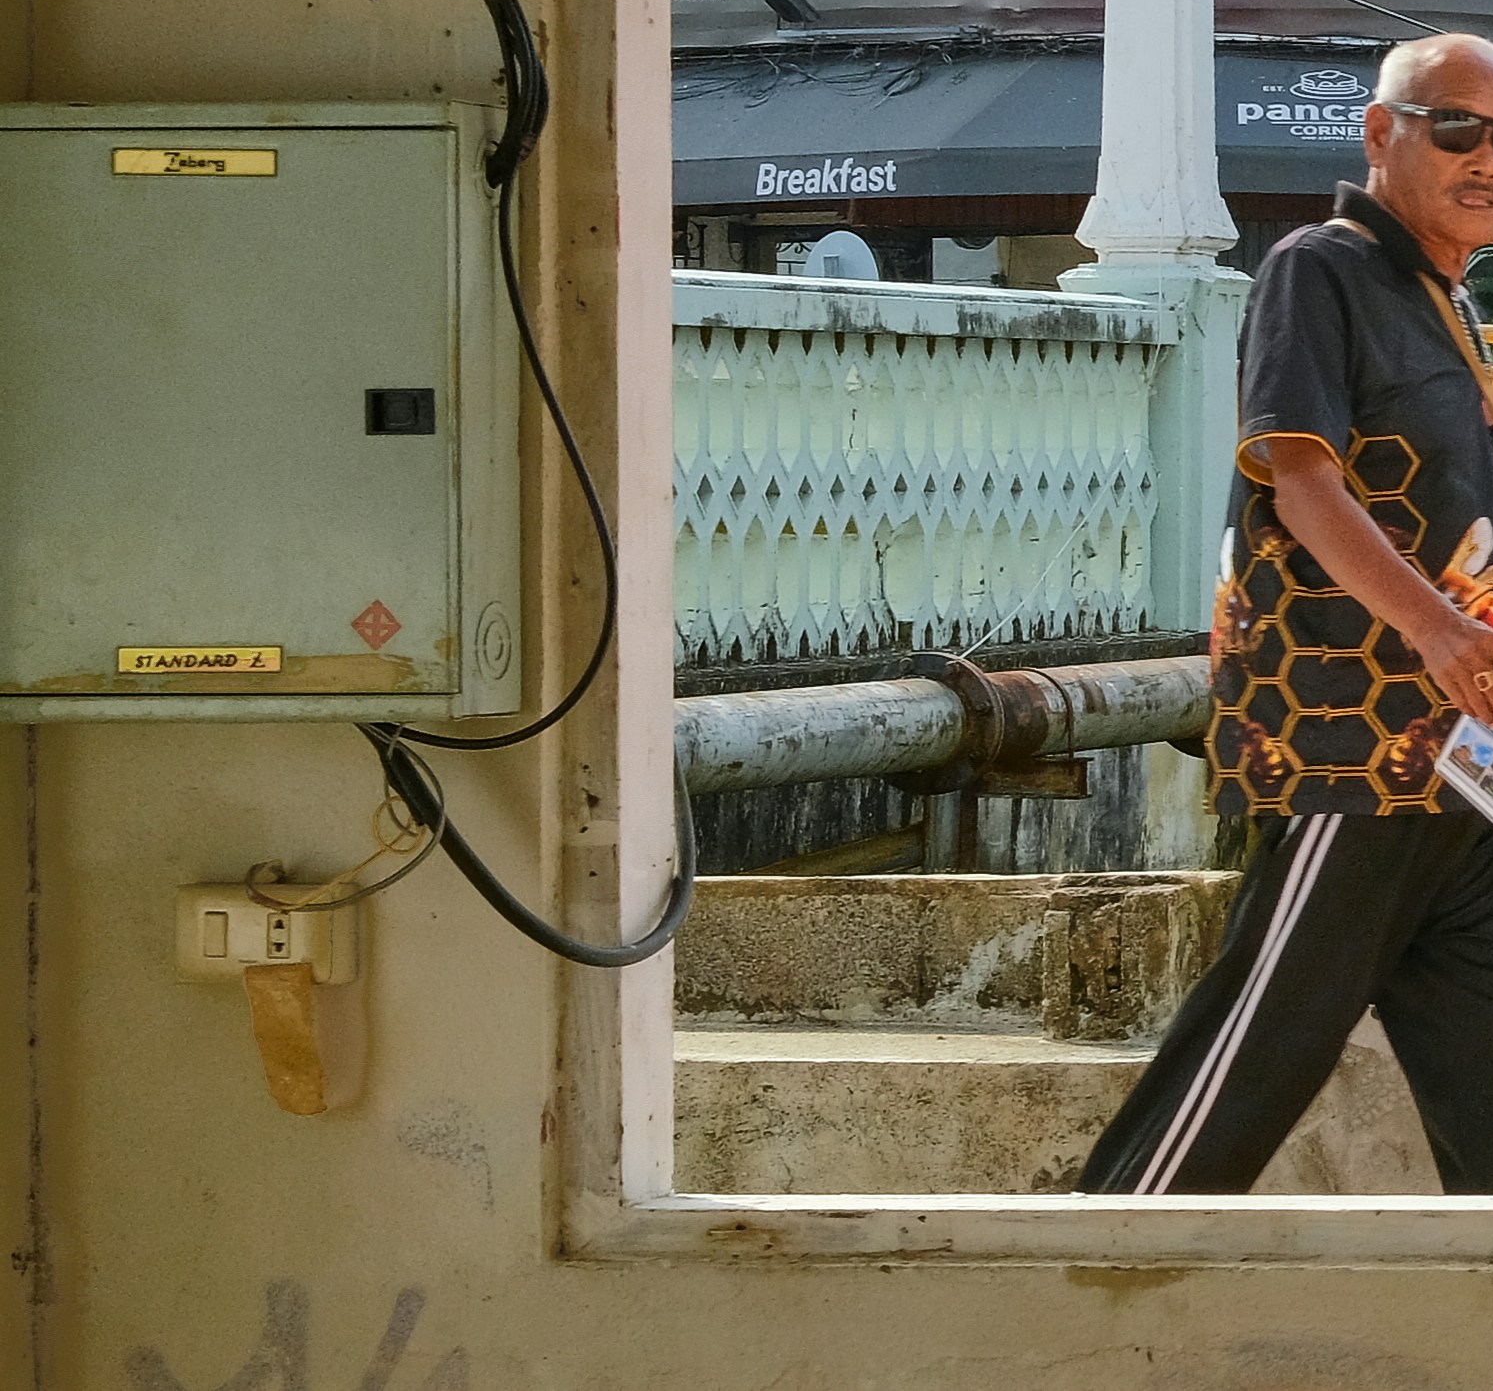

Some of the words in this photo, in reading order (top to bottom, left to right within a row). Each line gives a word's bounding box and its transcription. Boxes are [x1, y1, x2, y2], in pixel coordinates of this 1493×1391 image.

[1237, 103, 1367, 126] panca
[756, 157, 897, 196] Breakfast
[135, 653, 239, 669] STANDARD
